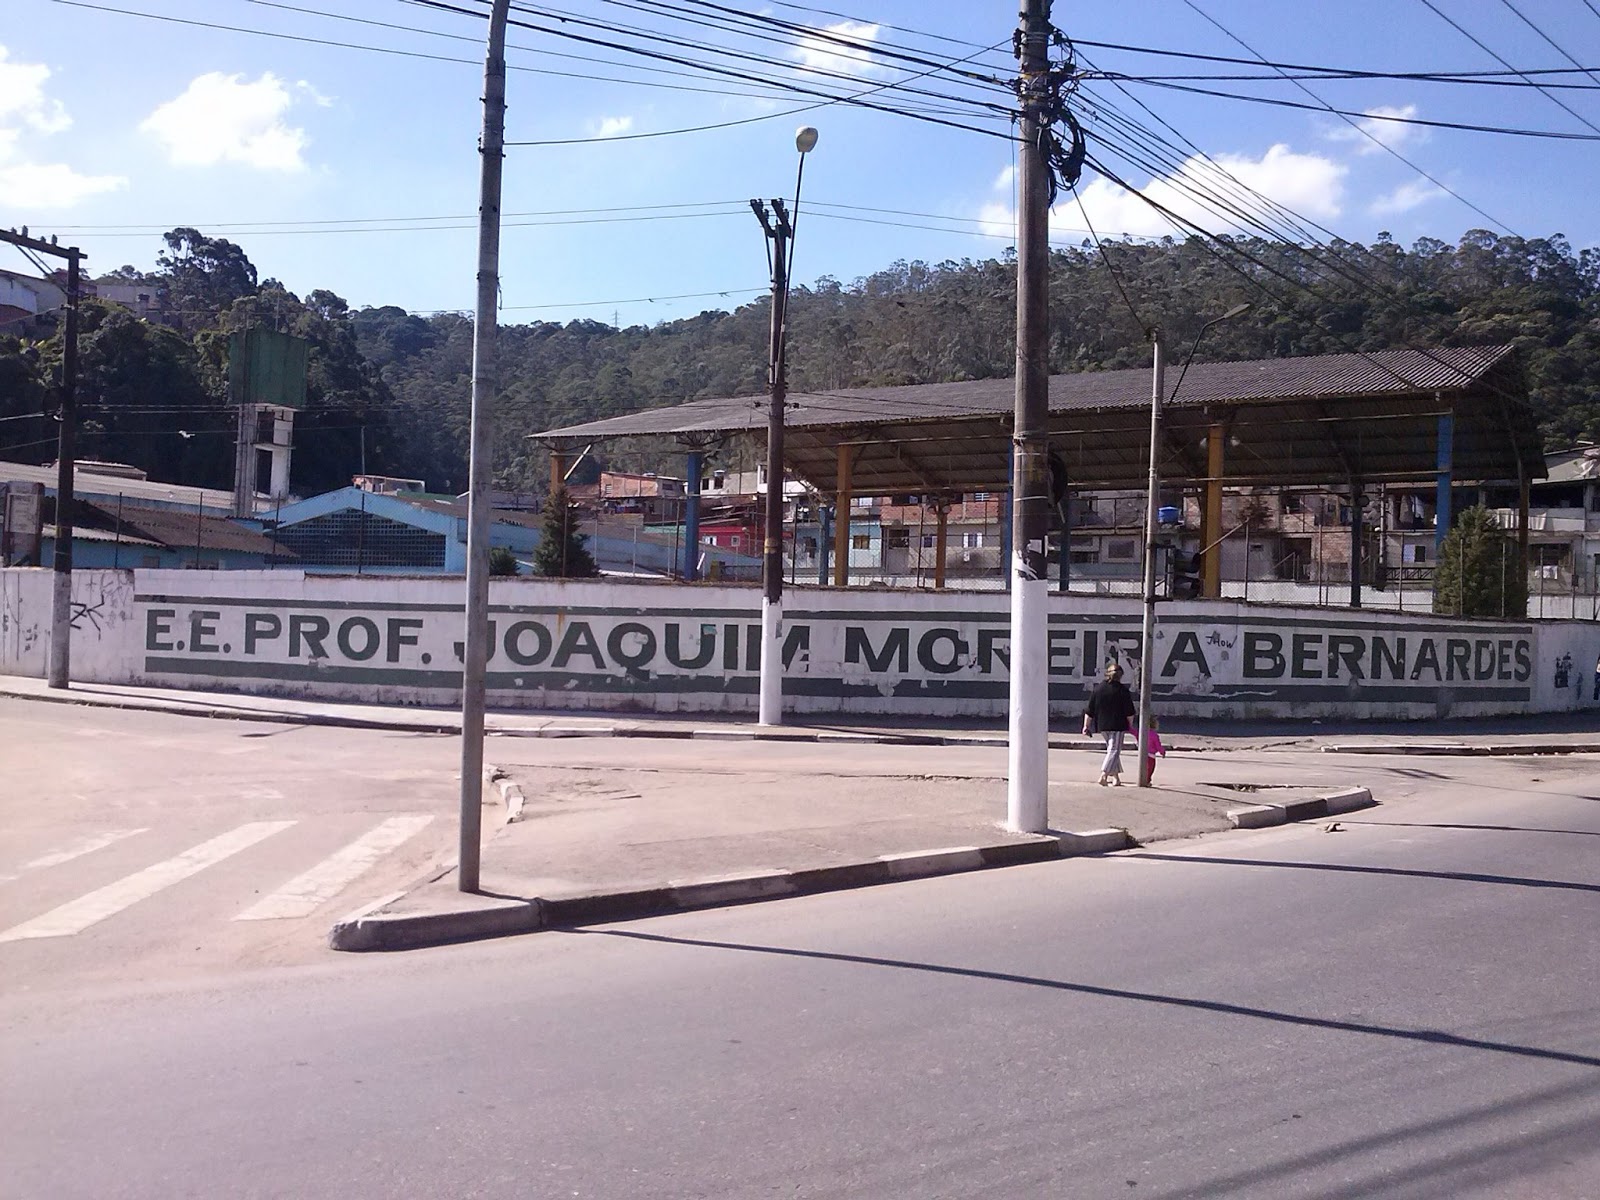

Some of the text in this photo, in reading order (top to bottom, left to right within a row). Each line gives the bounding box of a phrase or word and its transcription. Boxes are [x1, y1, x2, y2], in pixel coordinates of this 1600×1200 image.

[145, 609, 232, 654] E.E.
[244, 613, 432, 665] PROF.
[1242, 632, 1532, 682] BERNARDES
